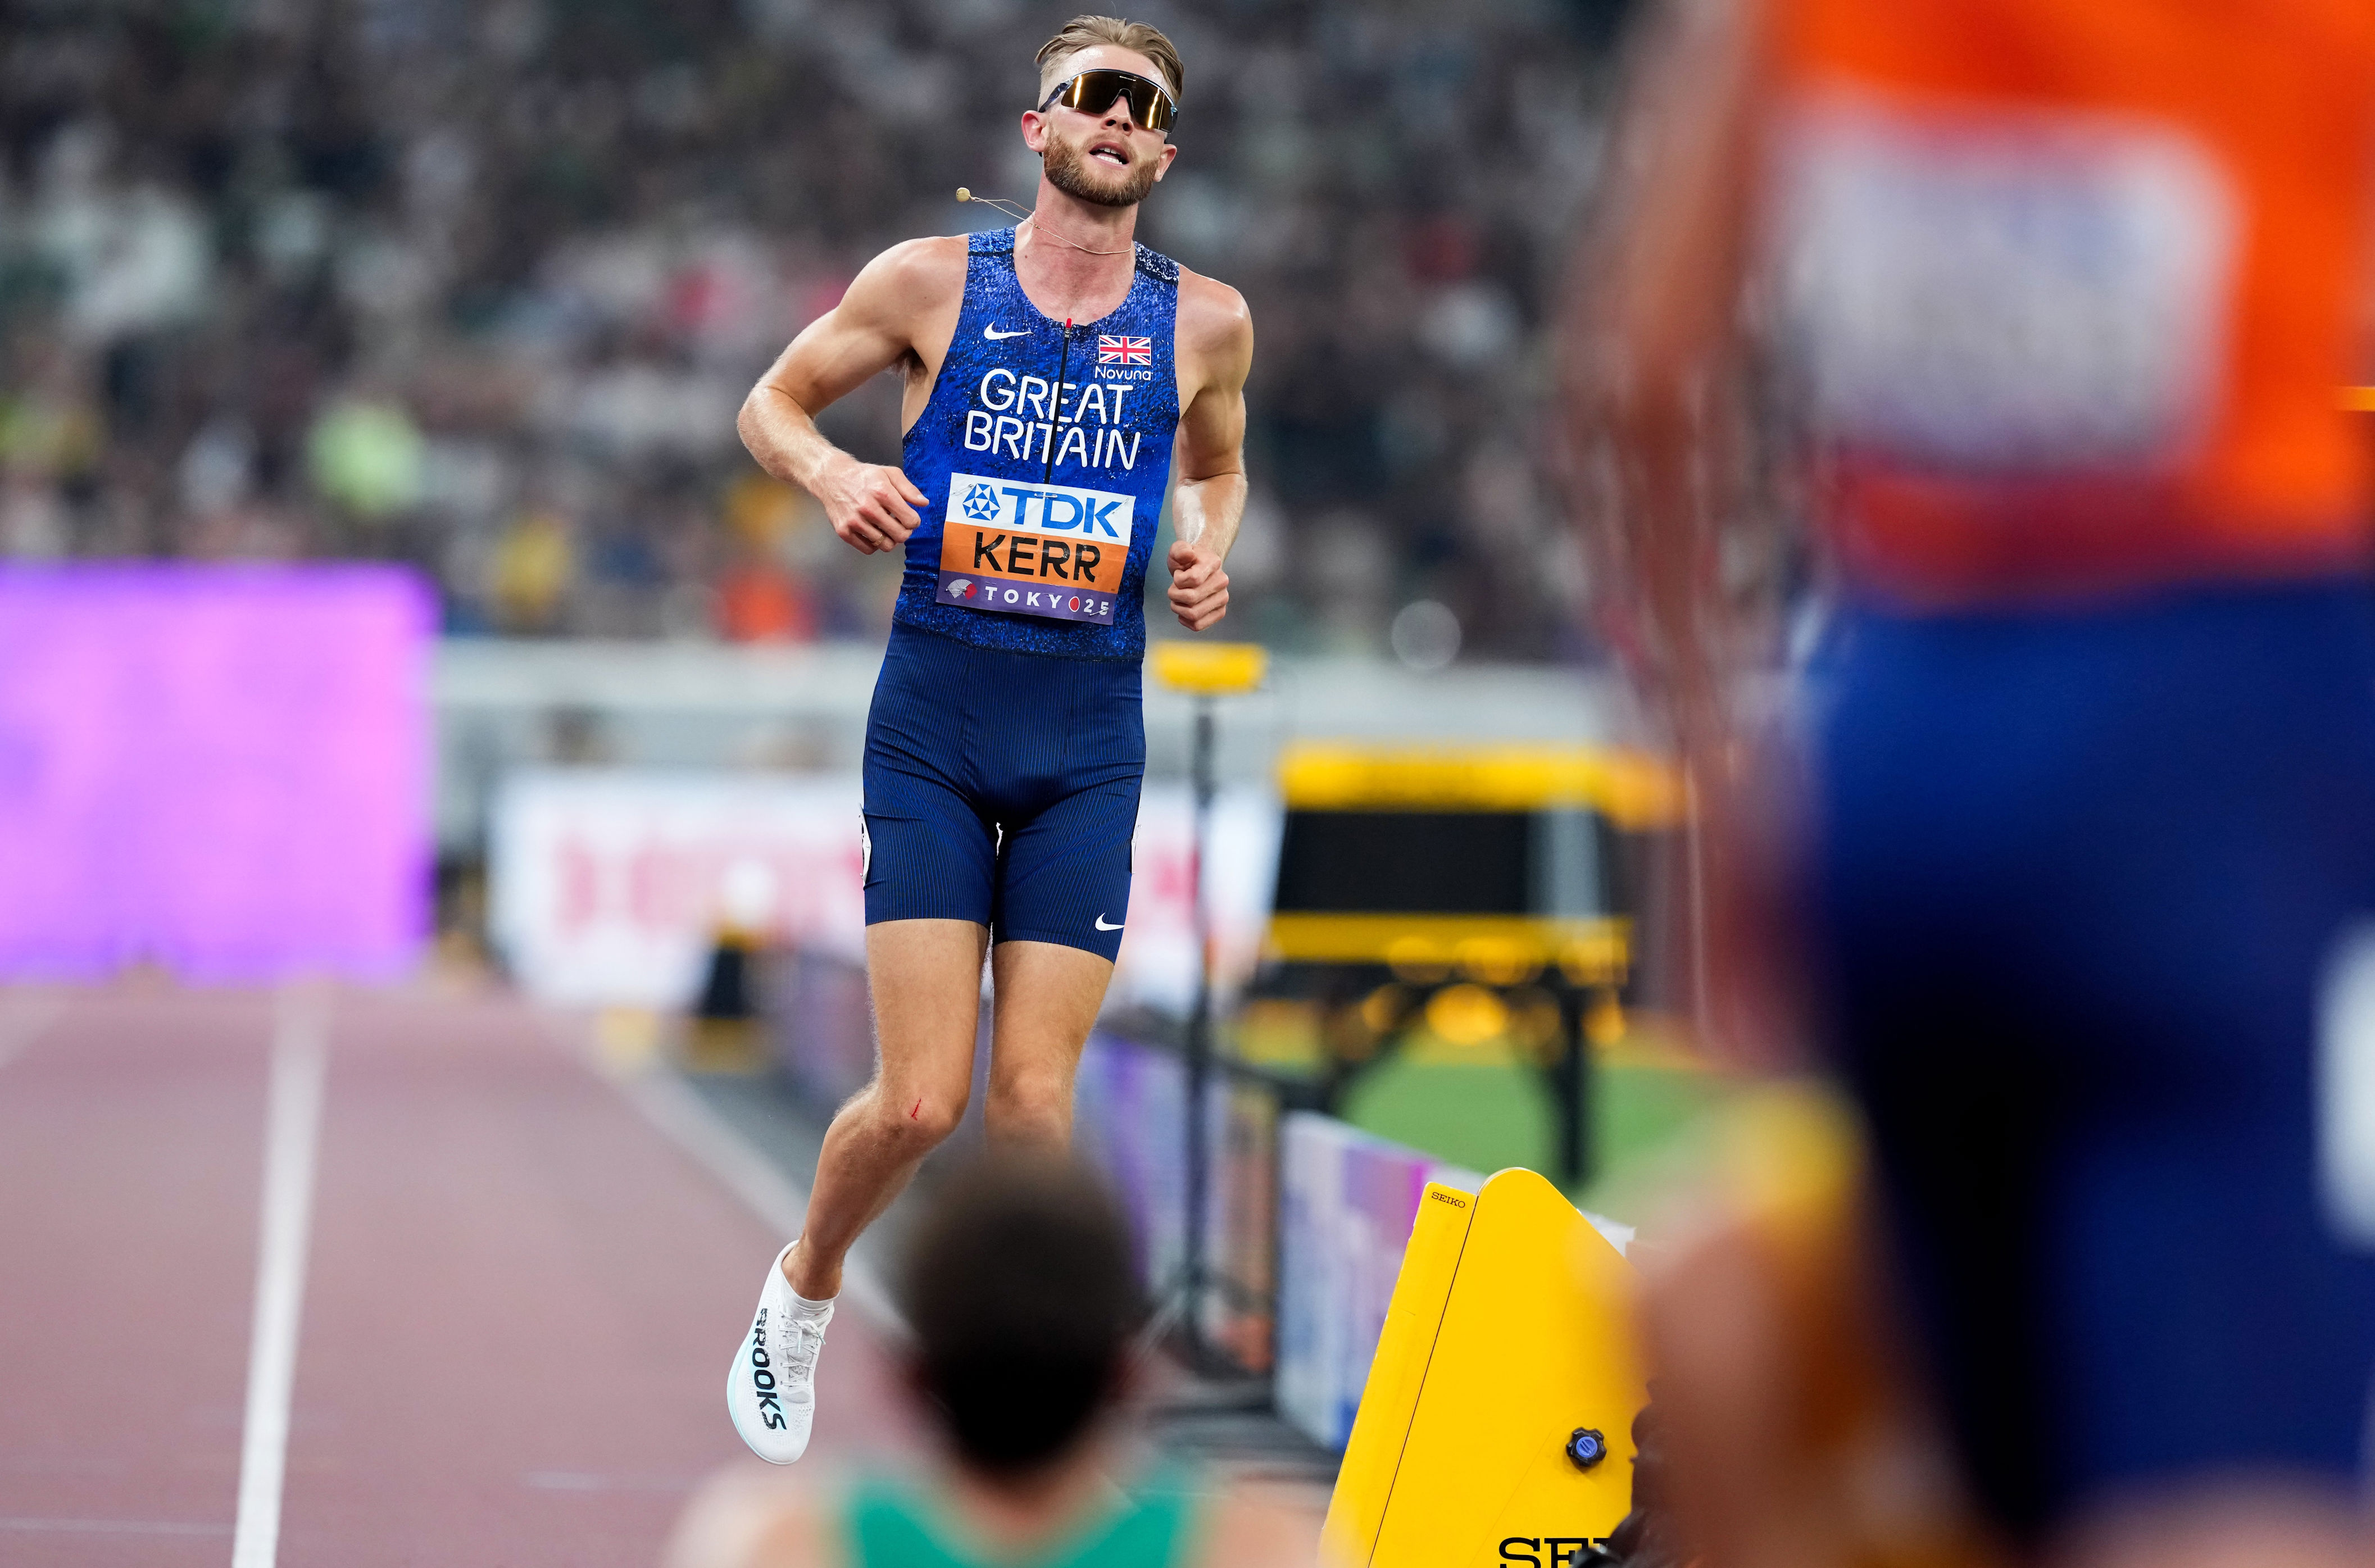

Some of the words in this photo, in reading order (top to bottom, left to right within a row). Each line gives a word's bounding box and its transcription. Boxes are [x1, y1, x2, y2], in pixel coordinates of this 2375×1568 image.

[980, 369, 1134, 424] GREAT
[1095, 366, 1151, 381] Novuna
[964, 410, 1141, 470] BRITAIN
[1002, 487, 1123, 538] TDK
[974, 531, 1101, 583] KERR
[1431, 1192, 1465, 1208] SEIKO
[752, 1308, 787, 1430] BROOKS
